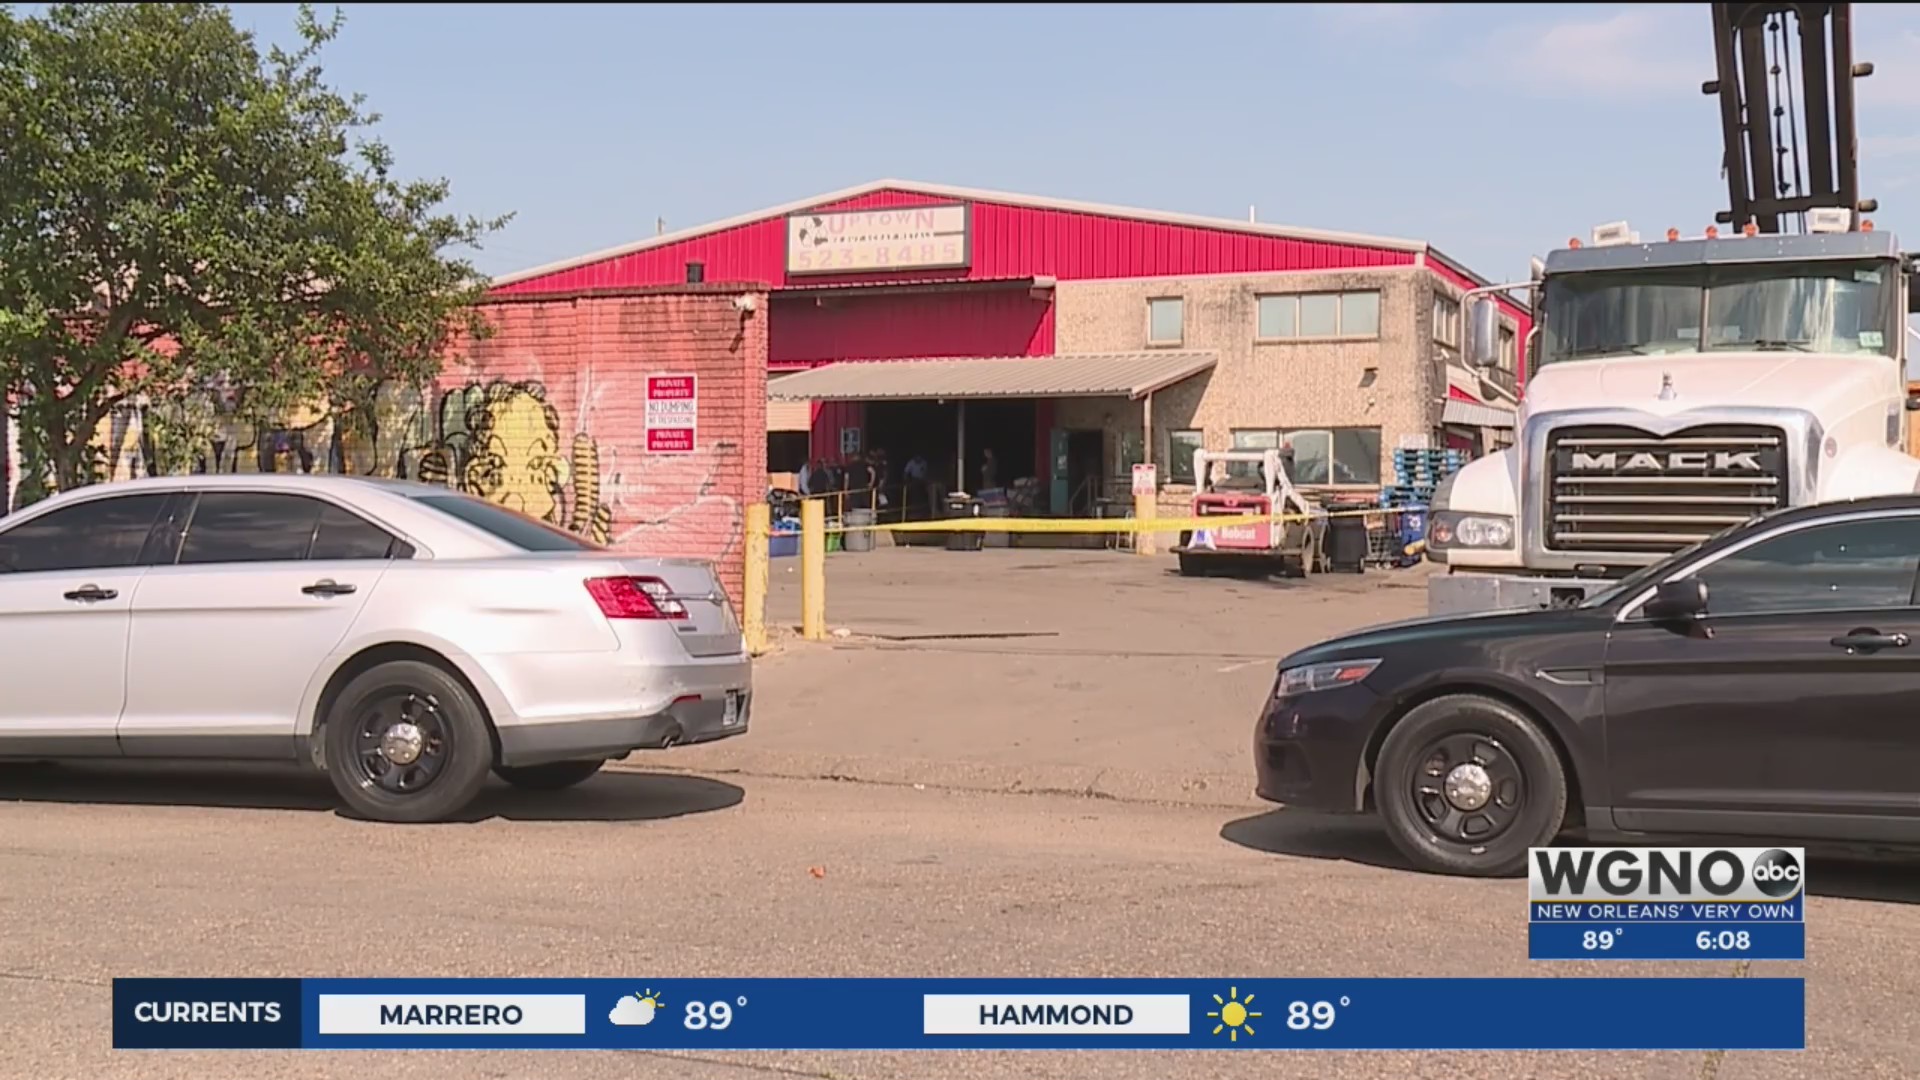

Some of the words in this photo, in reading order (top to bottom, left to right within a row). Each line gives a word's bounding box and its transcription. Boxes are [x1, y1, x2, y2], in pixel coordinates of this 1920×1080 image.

[828, 210, 936, 234] UPTOWN
[800, 243, 957, 268] 523-8485
[1571, 452, 1761, 471] MACK
[1221, 526, 1256, 540] Bobcat
